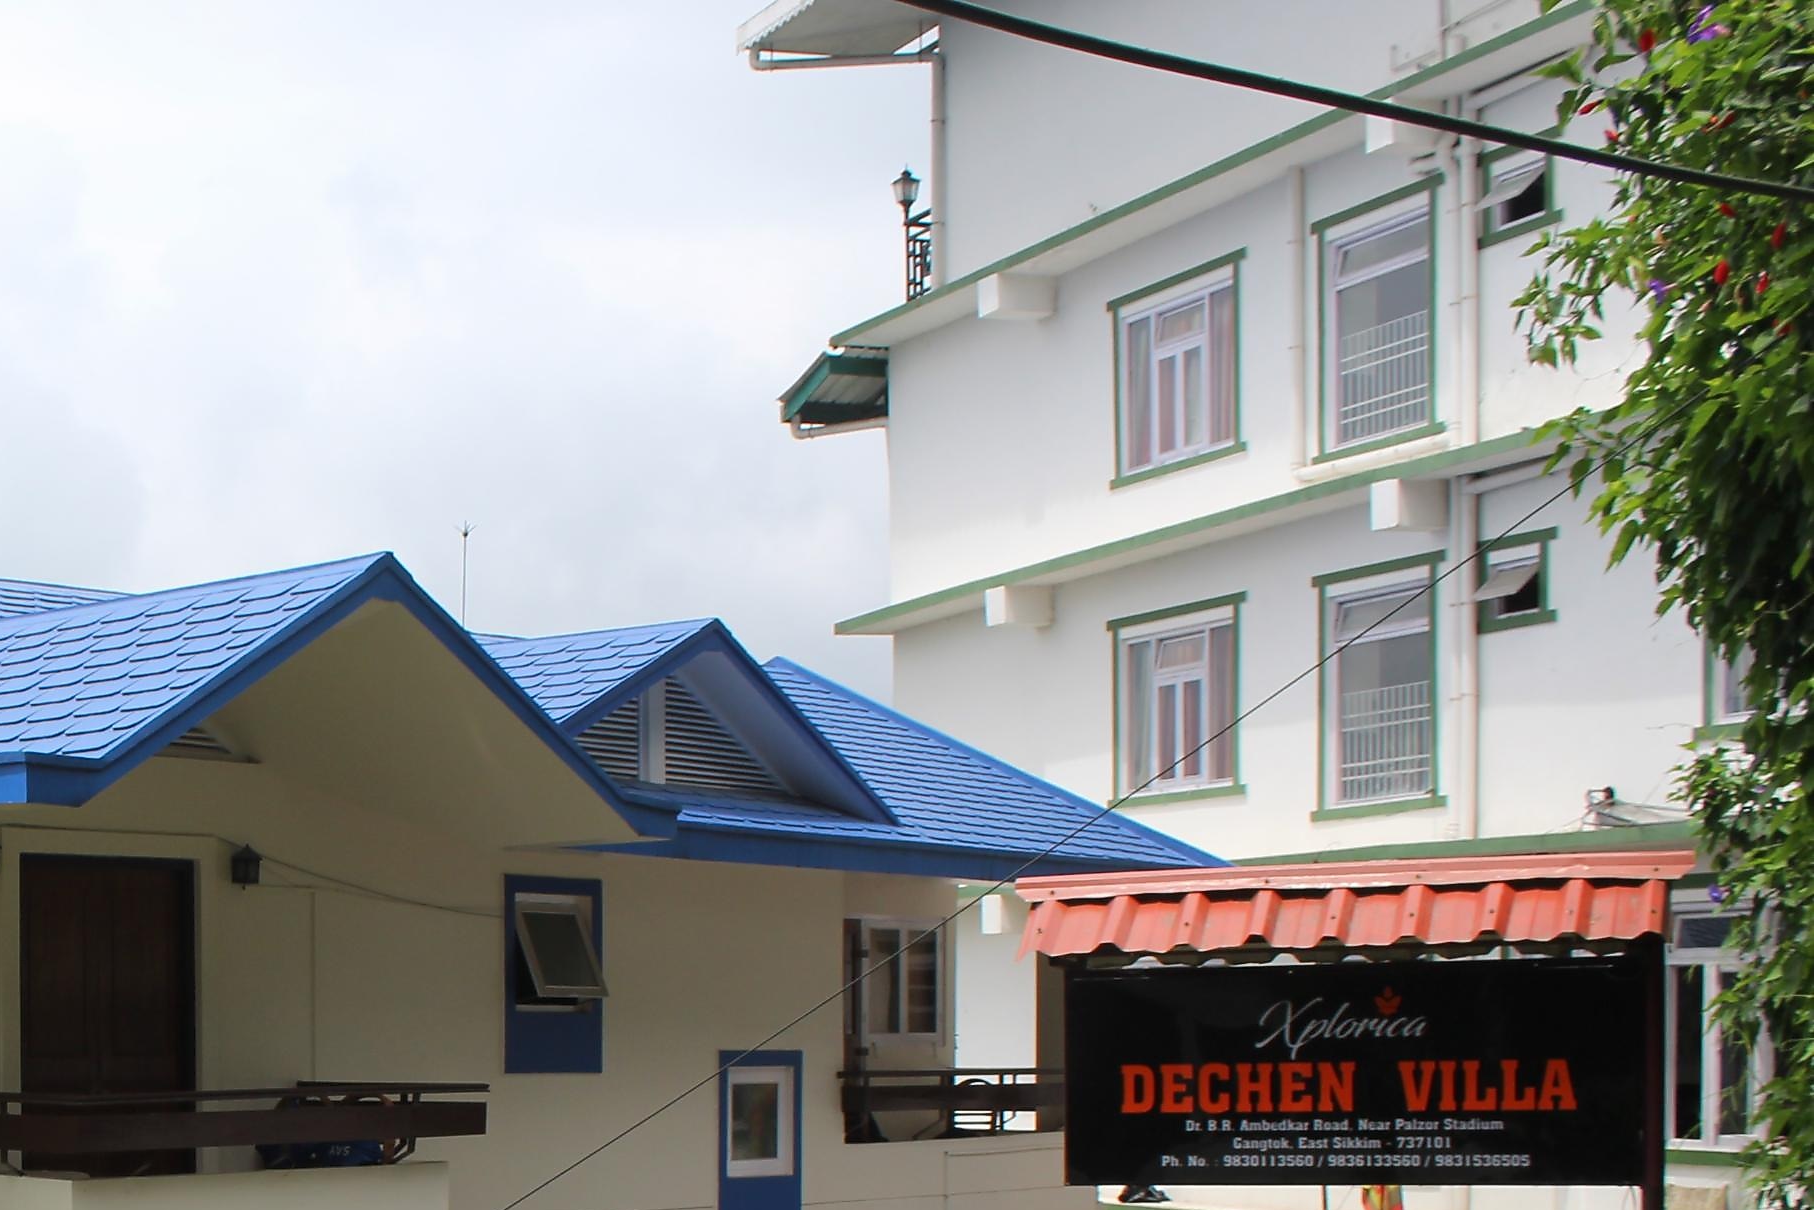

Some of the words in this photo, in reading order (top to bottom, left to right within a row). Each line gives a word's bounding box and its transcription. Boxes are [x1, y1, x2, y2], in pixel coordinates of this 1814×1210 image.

[1255, 997, 1428, 1061] Xplorica
[1120, 1062, 1356, 1114] DECHEN
[1398, 1059, 1578, 1112] VILLA
[1185, 1119, 1203, 1132] Dr.
[1239, 1119, 1310, 1132] Ambedkar
[1357, 1118, 1391, 1131] Near
[1394, 1118, 1440, 1131] Palzor
[1443, 1118, 1505, 1131] Stadium
[1297, 1136, 1329, 1149] East
[1332, 1136, 1382, 1149] Sikkim
[1396, 1136, 1452, 1149] 737101
[1161, 1154, 1183, 1167] Ph.
[1187, 1154, 1210, 1167] No.
[1222, 1154, 1315, 1167] 9830113560
[1327, 1154, 1421, 1167] 9836133560
[1434, 1154, 1531, 1167] 9831536505
